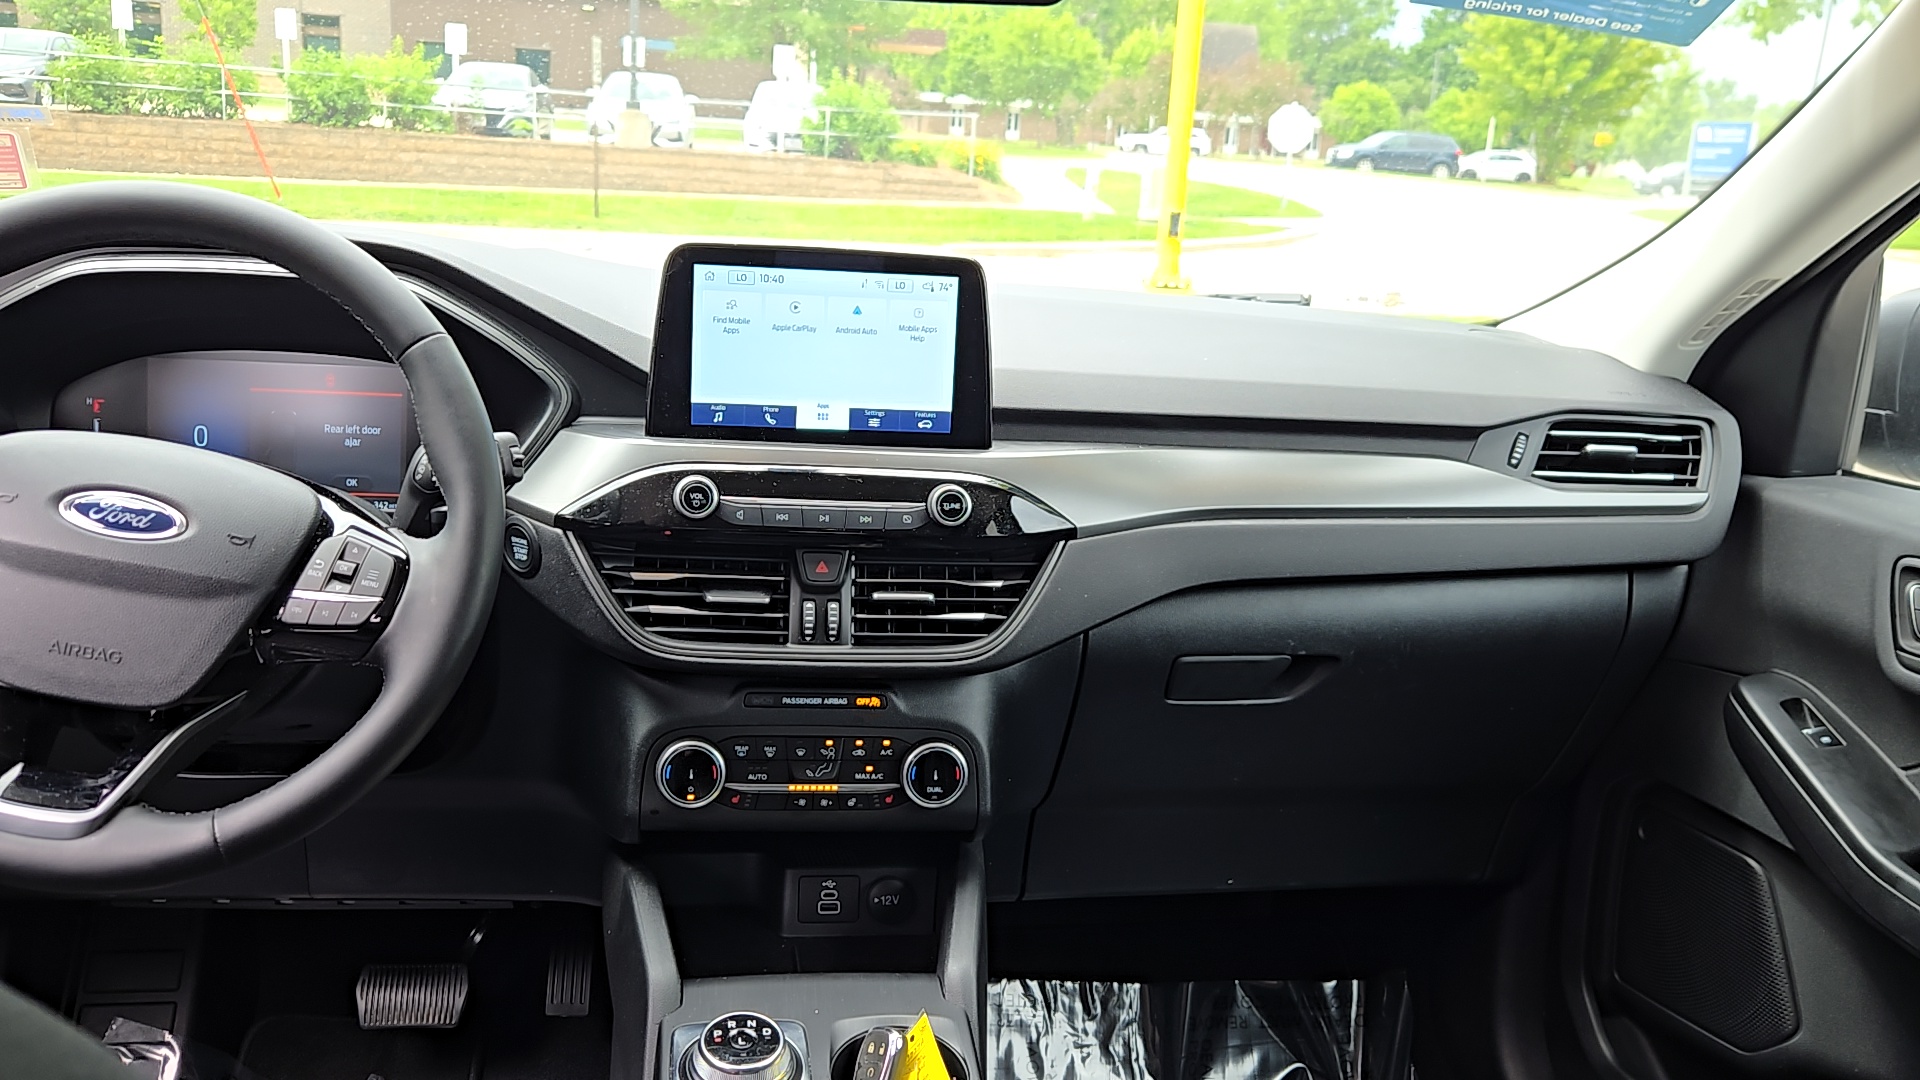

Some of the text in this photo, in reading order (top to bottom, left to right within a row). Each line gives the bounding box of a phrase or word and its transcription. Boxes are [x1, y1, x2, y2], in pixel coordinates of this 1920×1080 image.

[736, 274, 784, 284] LO 10:40
[895, 282, 906, 290] LO
[712, 316, 750, 326] Find Mobile
[722, 326, 740, 336] Apps
[772, 324, 816, 334] Apple CarPlay
[836, 326, 878, 336] Android Auto
[898, 324, 938, 334] Mobile Apps
[910, 334, 926, 343] Help
[86, 397, 92, 405] H
[864, 409, 886, 418] Settings
[324, 424, 382, 436] Rear left door
[193, 425, 208, 447] 0
[344, 437, 362, 448] ajar
[346, 478, 358, 488] OK
[690, 492, 704, 500] VOL
[89, 498, 152, 528] Ford
[307, 568, 322, 578] BACK
[361, 579, 380, 588] MENU
[48, 640, 124, 665] AIRBAG
[856, 697, 870, 706] OFF
[880, 895, 900, 906] 12V
[714, 1020, 772, 1038] P R N D
[738, 1037, 746, 1046] L
